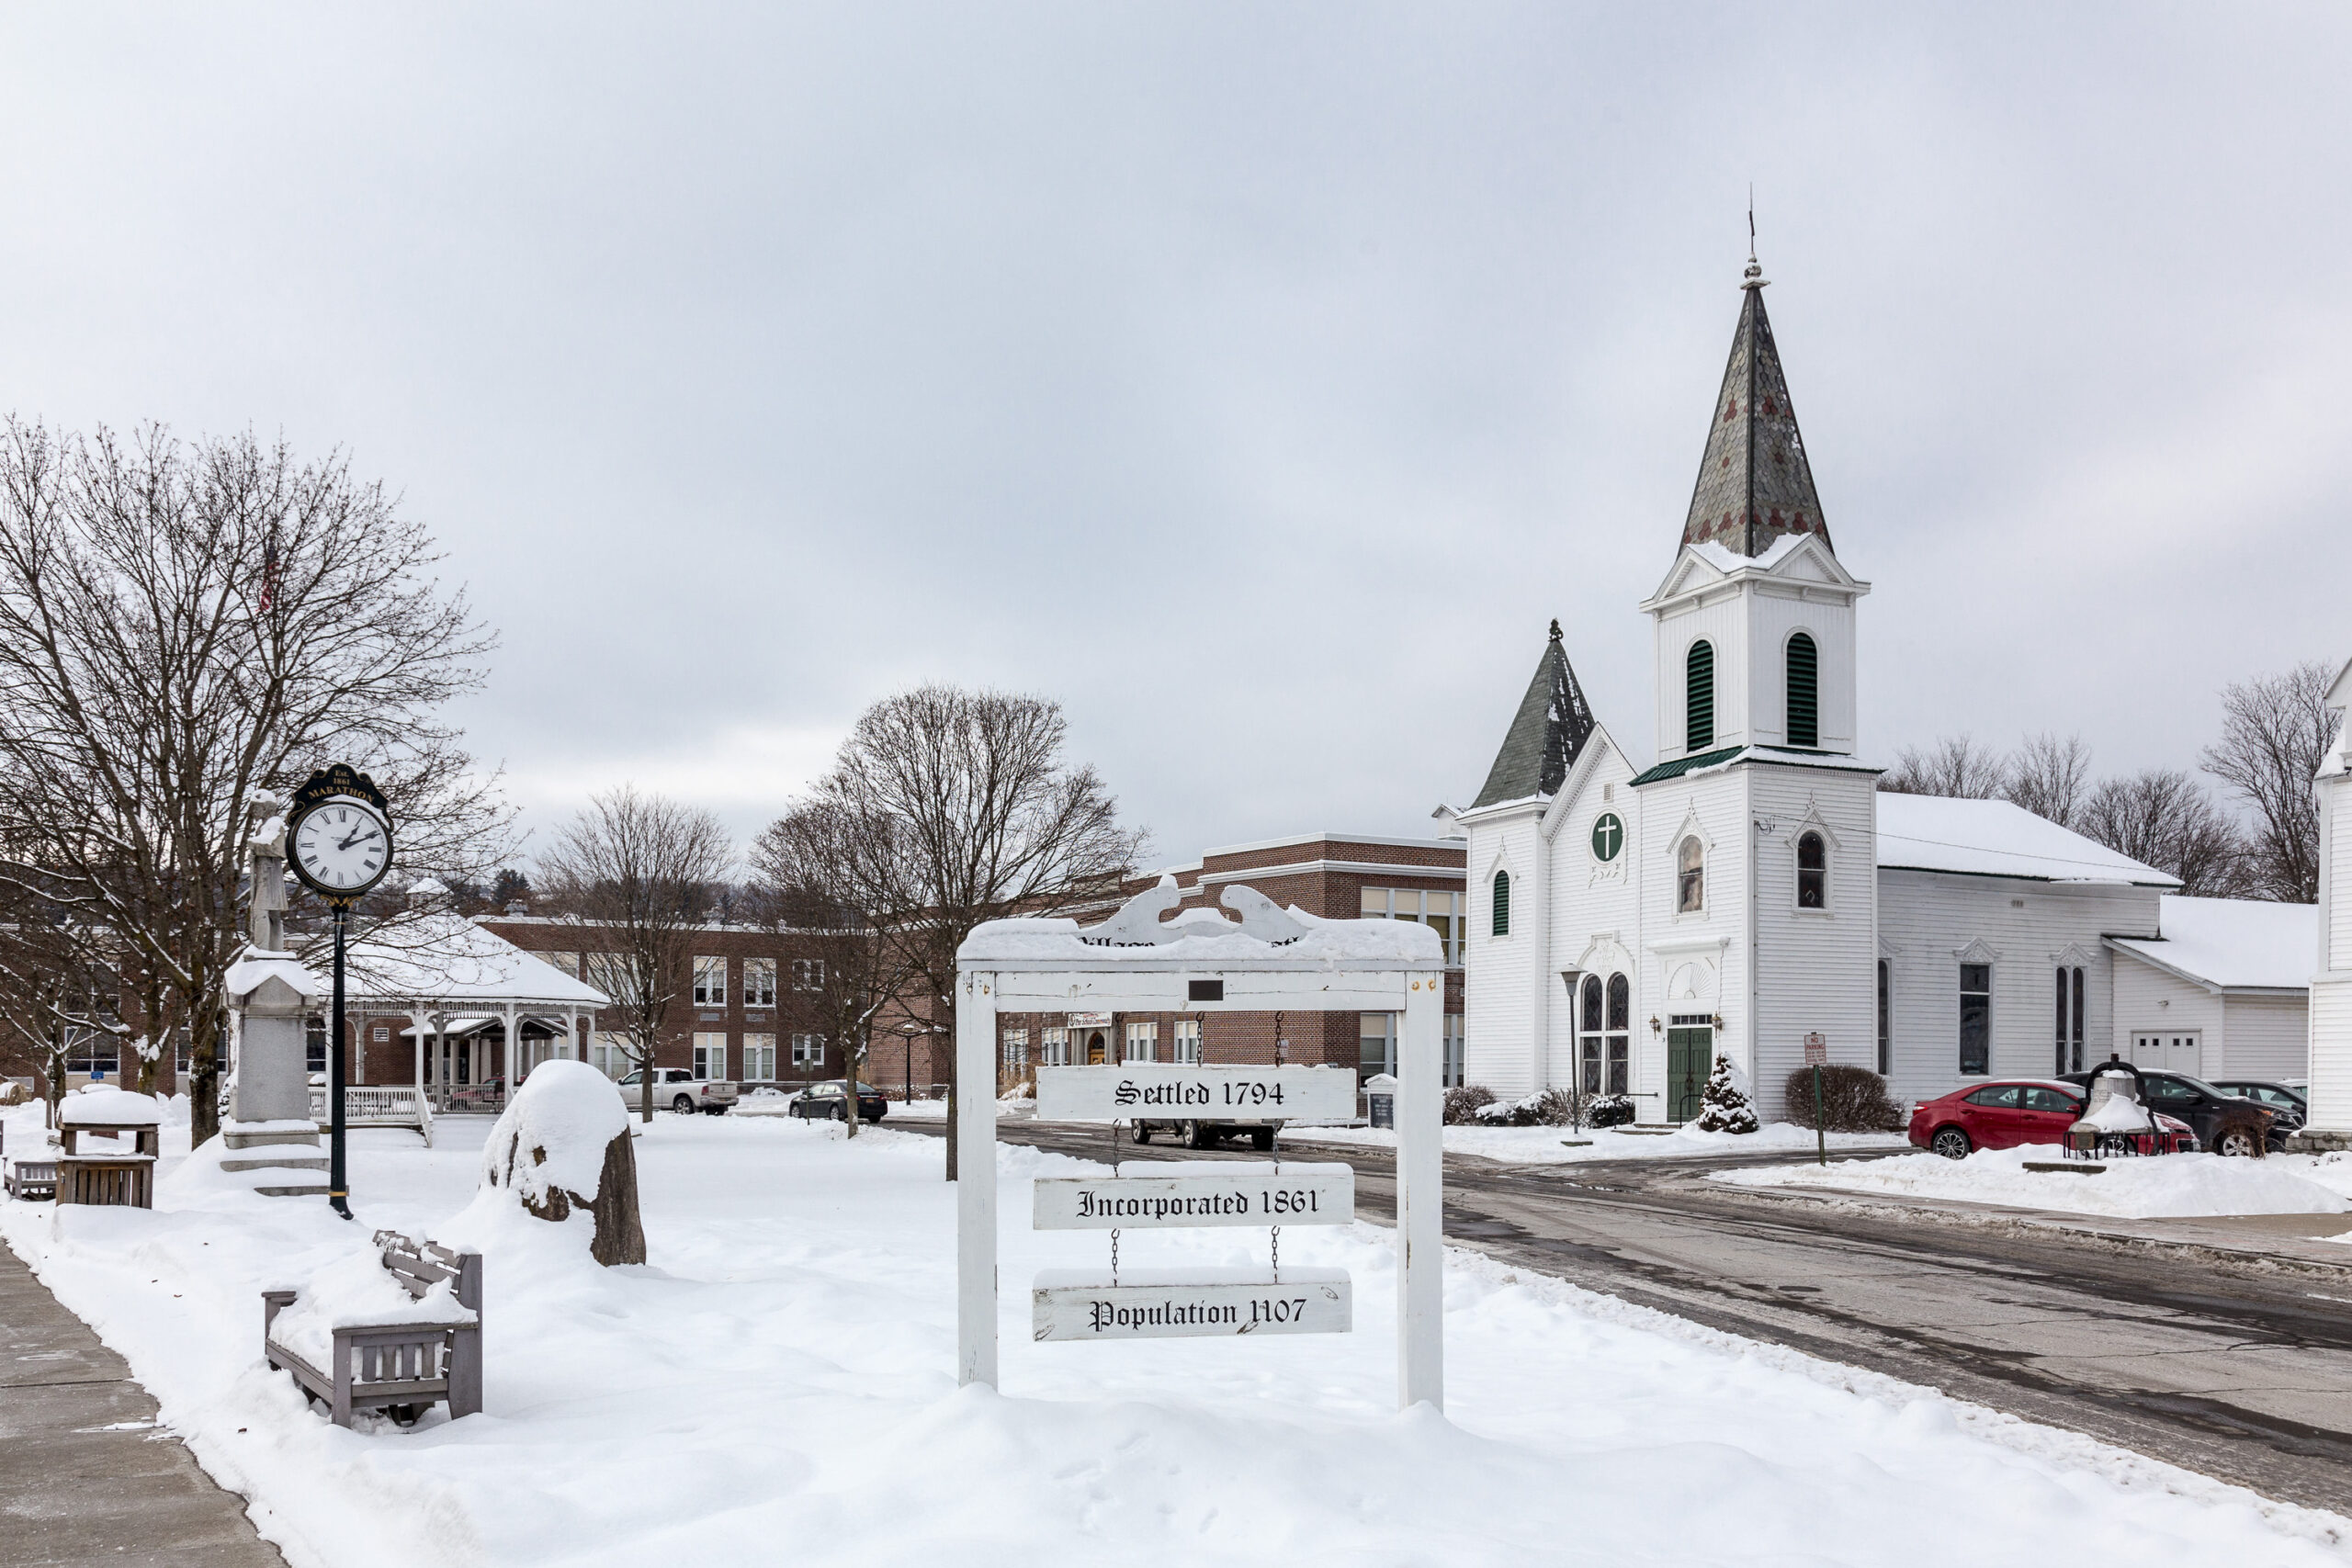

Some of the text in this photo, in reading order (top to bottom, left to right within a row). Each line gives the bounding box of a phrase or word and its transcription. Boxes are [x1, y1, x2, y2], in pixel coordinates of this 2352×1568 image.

[308, 785, 375, 803] MARATHON
[1114, 1079, 1284, 1106] Settled 1794
[1076, 1190, 1319, 1221] Incorporated 1861
[1087, 1298, 1307, 1333] Population 1107
